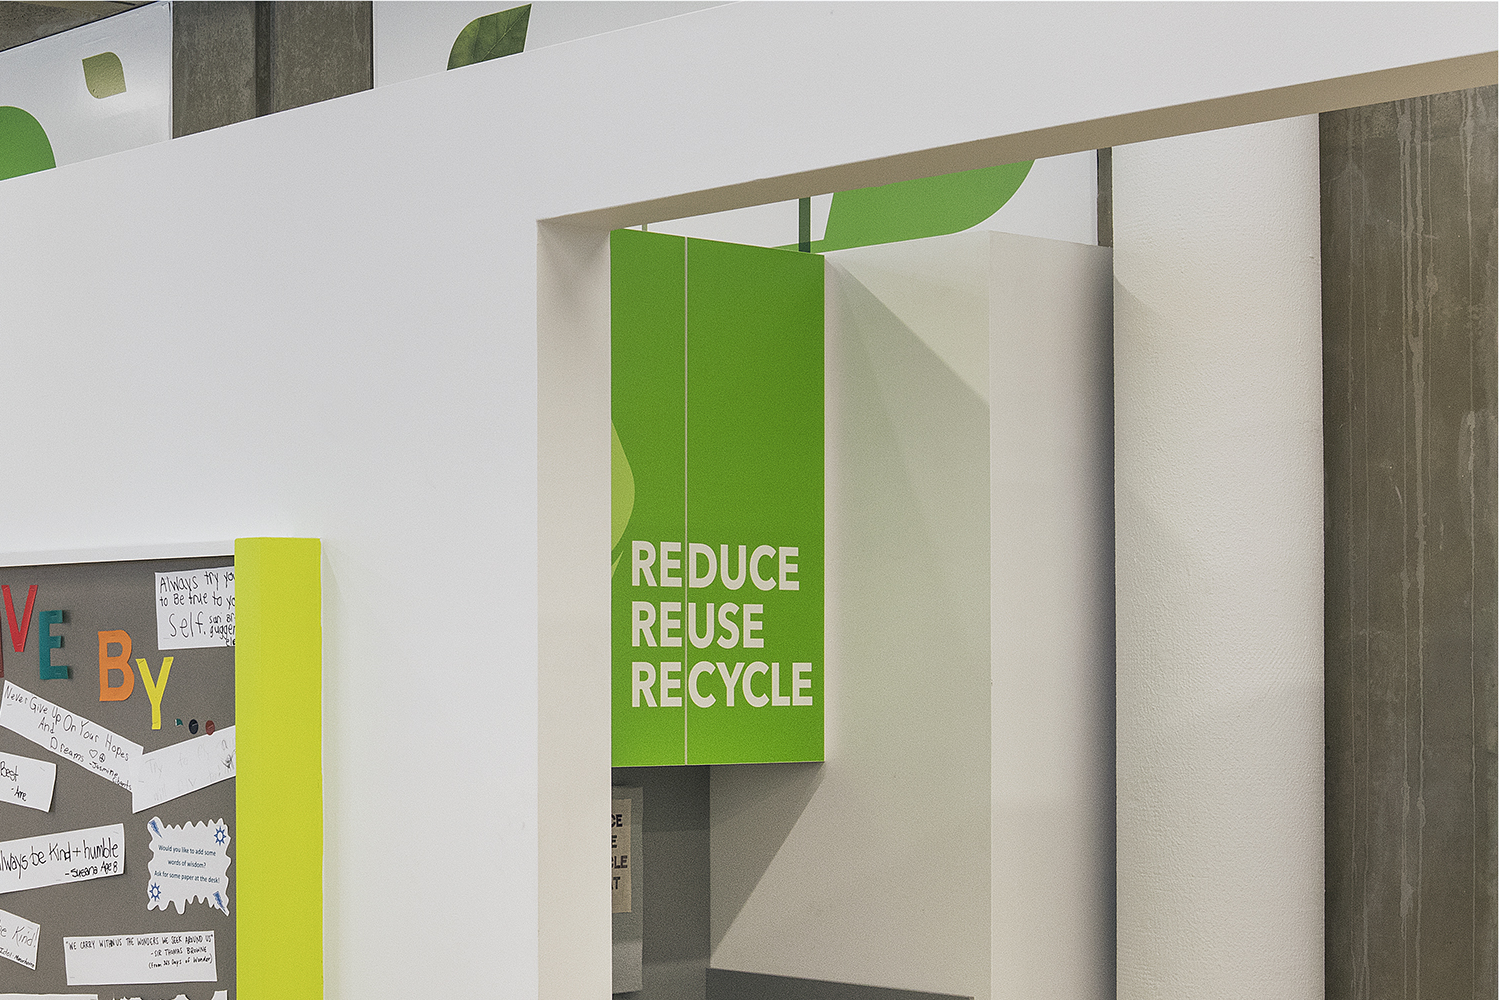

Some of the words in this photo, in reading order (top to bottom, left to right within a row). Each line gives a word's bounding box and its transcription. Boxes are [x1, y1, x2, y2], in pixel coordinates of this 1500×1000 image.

[631, 540, 800, 591] REDUCE
[160, 576, 198, 593] Always
[204, 571, 218, 590] try
[160, 596, 168, 606] to
[174, 593, 184, 605] Be
[188, 592, 208, 604] true
[212, 591, 222, 606] to
[631, 600, 765, 649] REUSE
[631, 660, 814, 708] RECYCLE
[4, 686, 28, 704] Never
[30, 697, 48, 714] Give
[52, 707, 62, 725] Up
[63, 715, 77, 732] On
[80, 720, 100, 742] Your
[105, 734, 129, 762] Hopes
[38, 716, 56, 734] And
[50, 736, 85, 762] Dreams
[0, 761, 18, 782] Best
[30, 846, 46, 866] be
[83, 838, 118, 860] humble
[100, 862, 112, 874] Age
[113, 861, 118, 873] 8
[80, 940, 96, 950] CARRY
[126, 937, 134, 946] THE
[137, 936, 159, 946] WONDERS
[162, 936, 169, 944] WE
[170, 935, 182, 944] SEEK
[184, 934, 203, 944] AROUND
